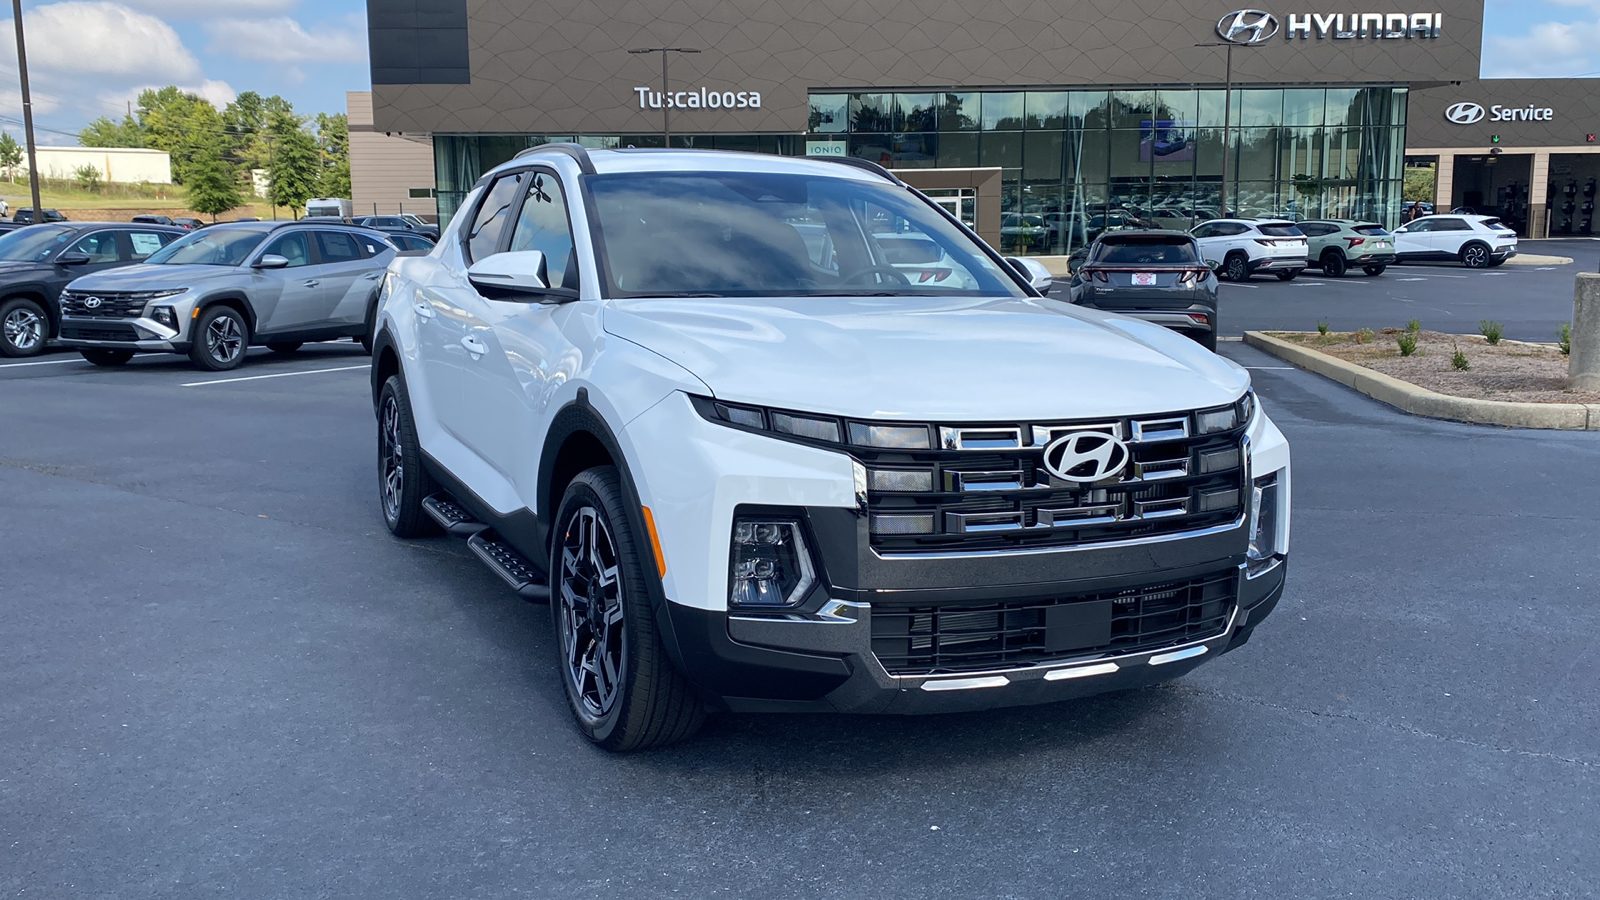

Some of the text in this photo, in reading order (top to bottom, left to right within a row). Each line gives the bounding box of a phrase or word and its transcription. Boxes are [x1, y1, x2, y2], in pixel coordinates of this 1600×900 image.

[1287, 12, 1442, 38] HYUNDAI
[634, 86, 761, 109] Tuscaloosa
[1490, 104, 1553, 121] Service
[810, 146, 842, 154] IONIQ
